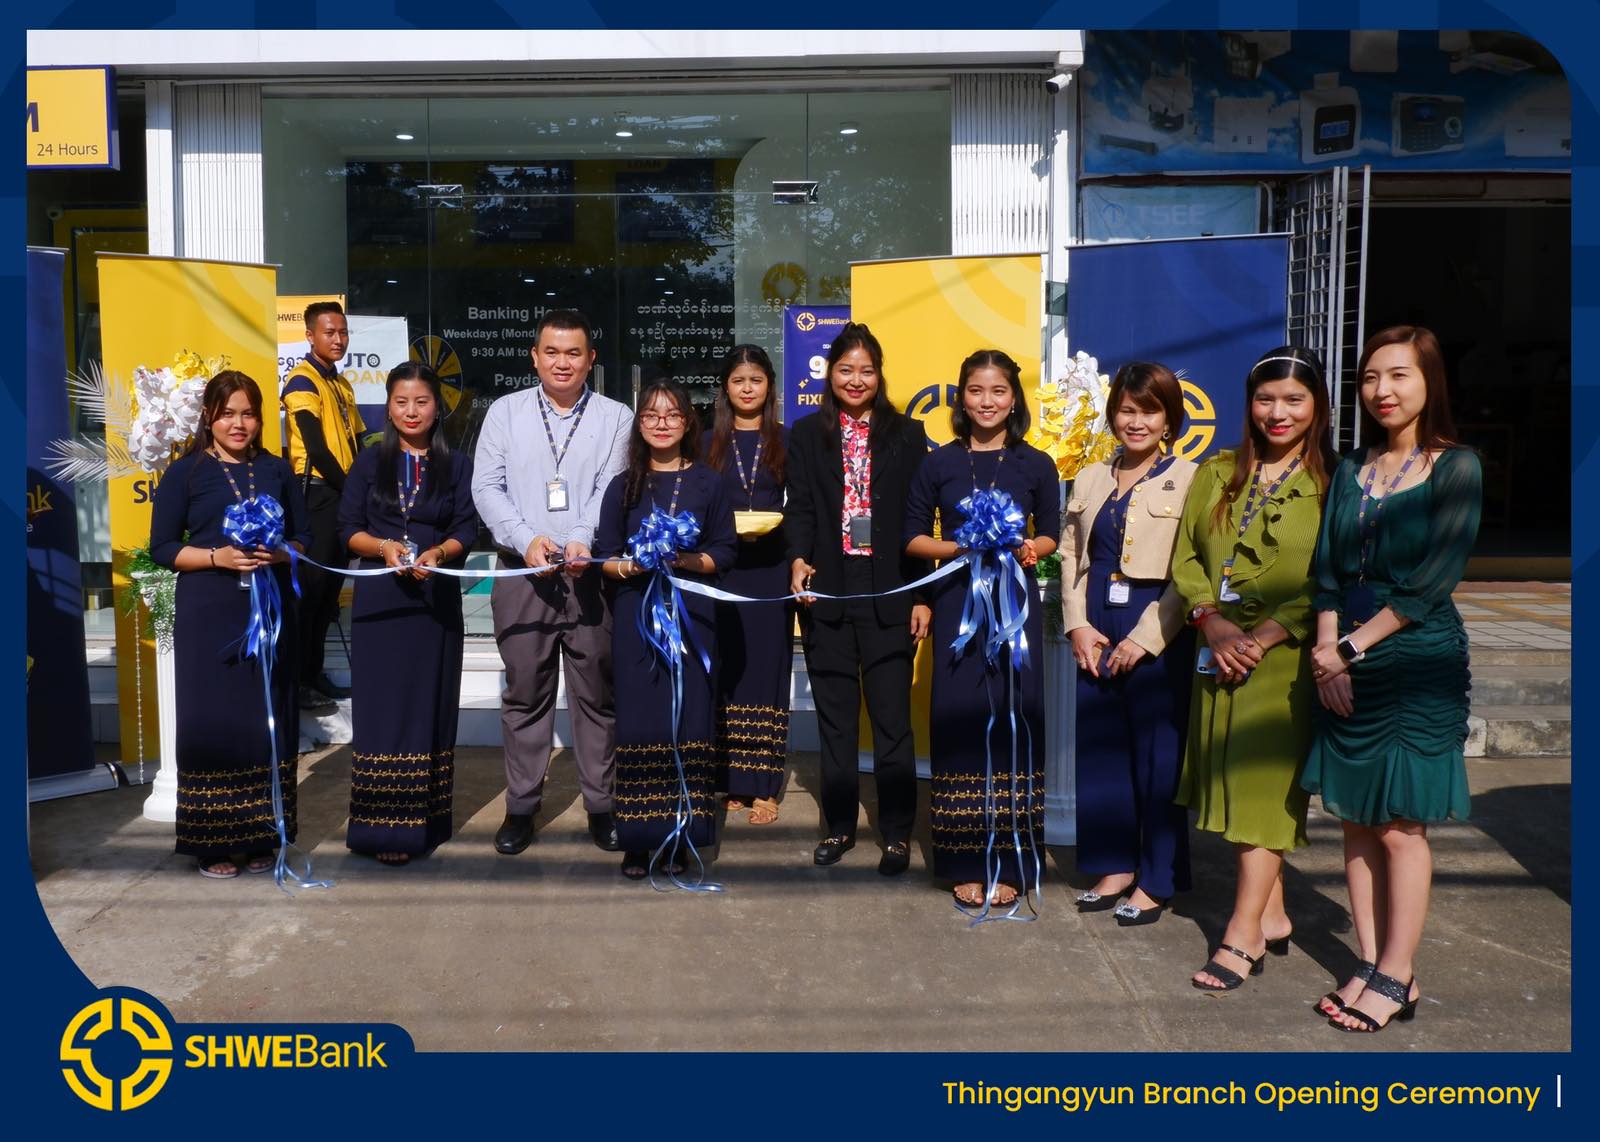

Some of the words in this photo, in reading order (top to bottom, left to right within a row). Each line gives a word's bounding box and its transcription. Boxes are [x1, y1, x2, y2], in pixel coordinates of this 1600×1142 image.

[37, 144, 53, 156] 24
[58, 143, 98, 156] Hours
[468, 306, 529, 322] Banking
[443, 328, 498, 340] Weekdays
[471, 347, 495, 357] 9:30
[497, 347, 514, 357] AM
[517, 347, 528, 357] to
[343, 353, 380, 368] UTO
[344, 369, 389, 384] OAN
[494, 373, 540, 389] Payda
